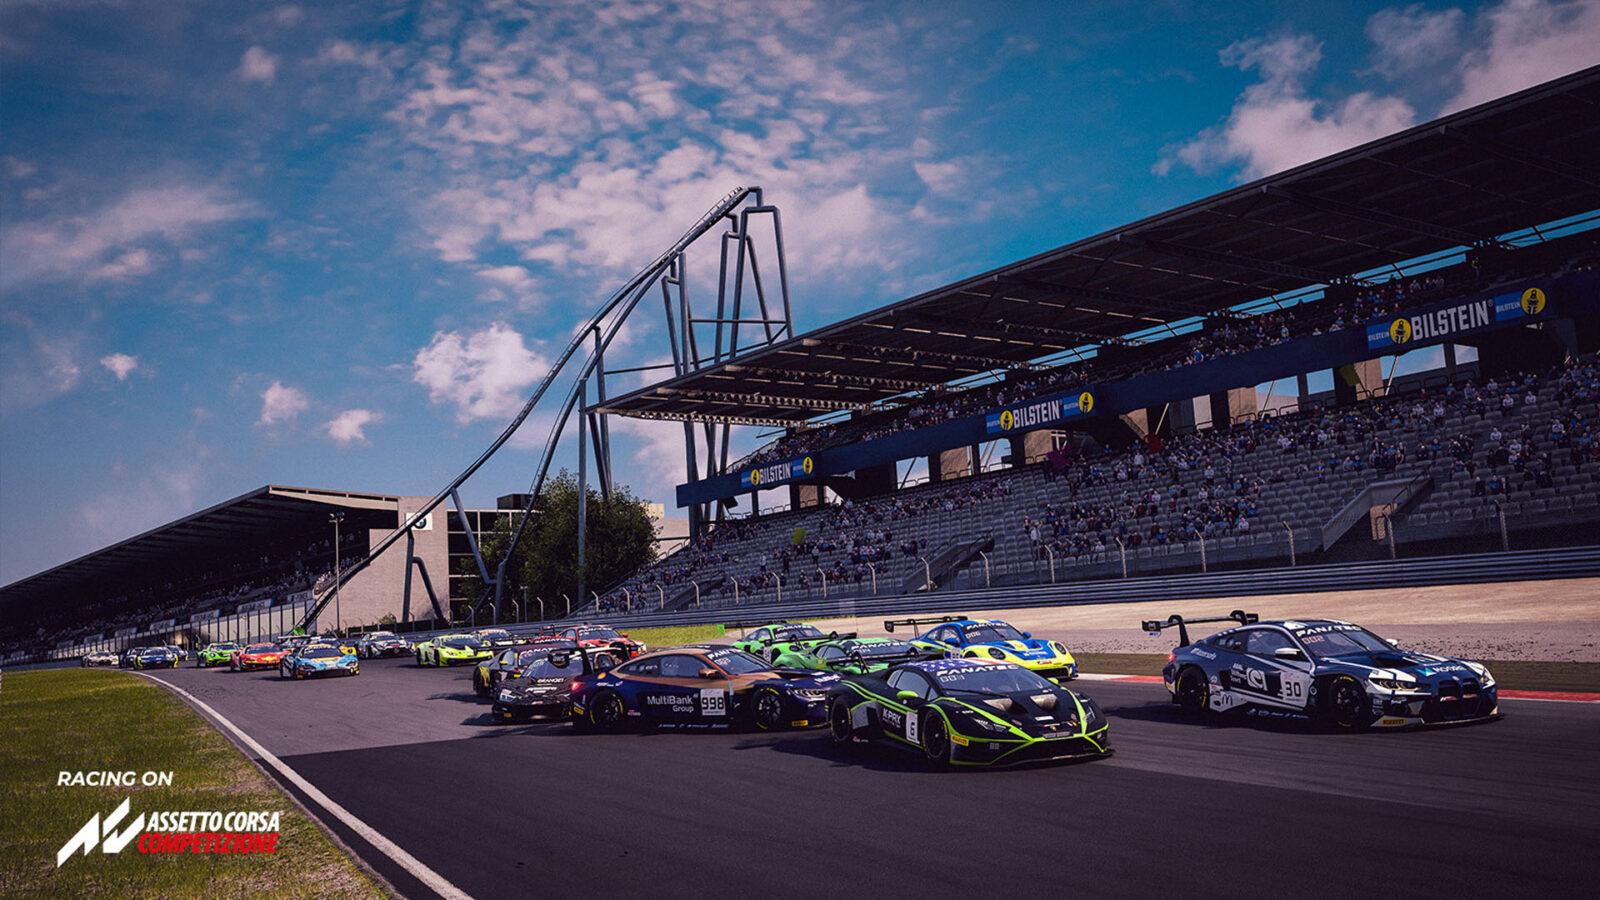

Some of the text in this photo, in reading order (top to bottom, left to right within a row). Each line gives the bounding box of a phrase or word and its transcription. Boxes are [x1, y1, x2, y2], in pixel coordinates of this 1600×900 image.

[1411, 301, 1490, 341] BILSTEIN
[1013, 400, 1060, 429] BILSTEIN
[760, 463, 791, 484] BILSTEIN
[936, 664, 1019, 676] FANATEC
[1285, 681, 1302, 697] 30
[647, 695, 693, 704] MultiBank
[702, 697, 724, 710] 998
[672, 705, 694, 713] Group
